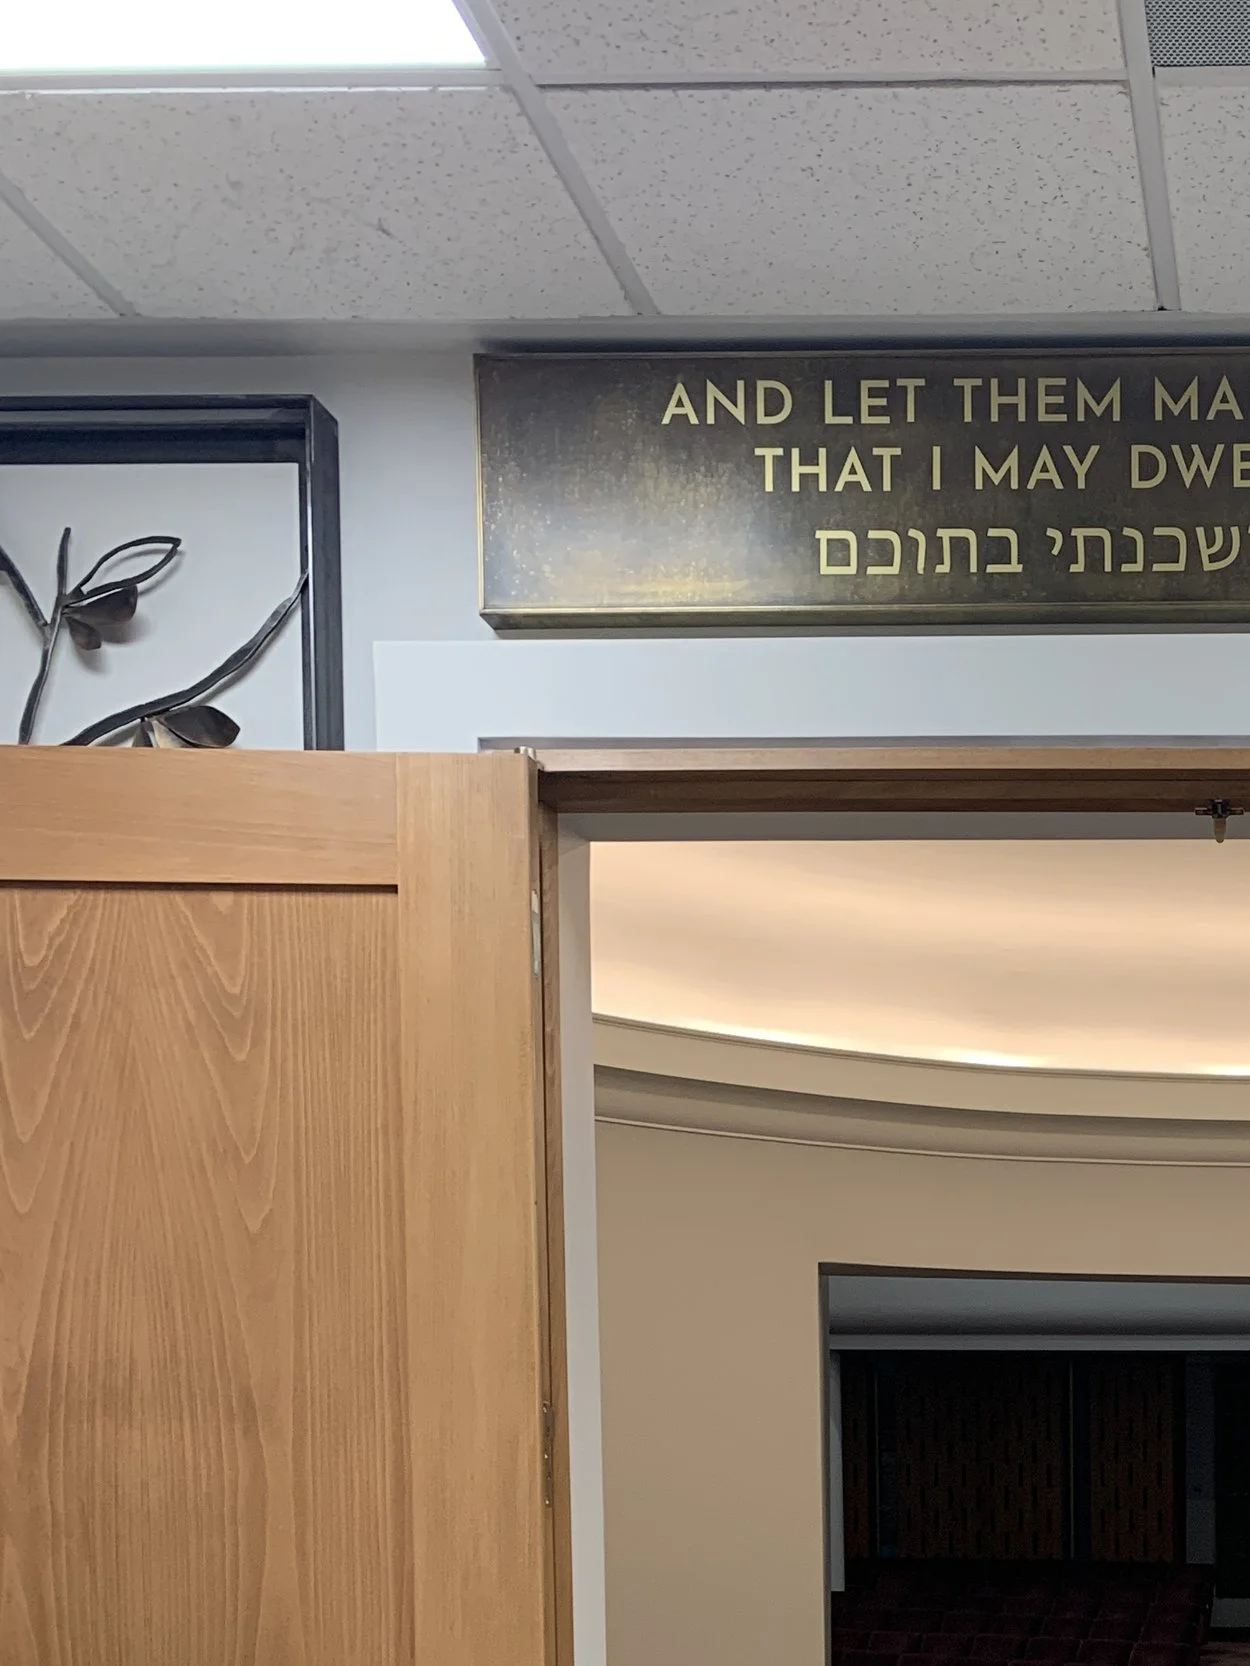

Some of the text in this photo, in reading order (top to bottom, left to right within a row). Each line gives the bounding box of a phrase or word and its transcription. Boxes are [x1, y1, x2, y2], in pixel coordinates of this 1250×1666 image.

[660, 378, 793, 426] AND
[824, 378, 926, 425] LET
[953, 377, 1121, 423] THEM
[754, 446, 902, 493] THAT
[932, 445, 942, 491] I
[974, 444, 1100, 490] MAY
[814, 528, 1024, 575] בתוכם
